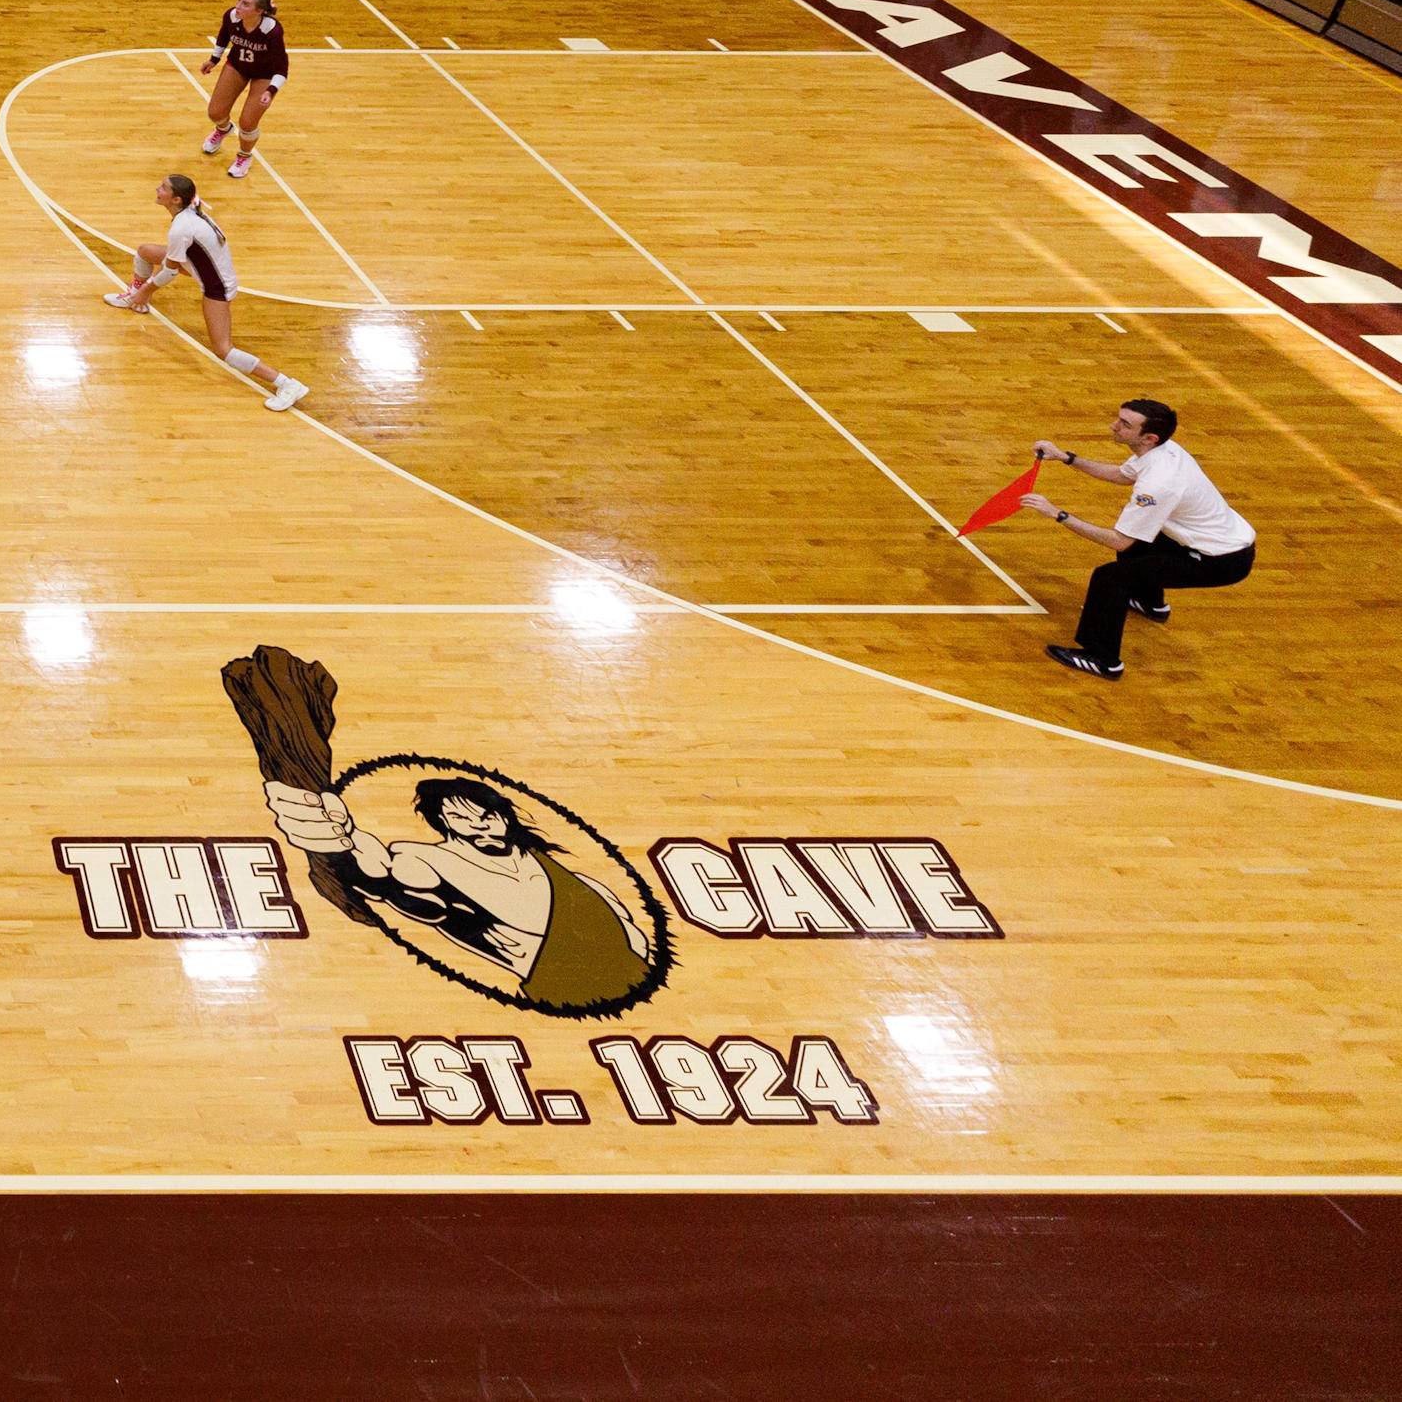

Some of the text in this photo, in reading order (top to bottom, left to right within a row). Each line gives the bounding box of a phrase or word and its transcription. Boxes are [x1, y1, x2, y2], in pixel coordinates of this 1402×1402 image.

[238, 48, 255, 64] 13
[52, 836, 1005, 939] THE CAVE
[342, 1034, 880, 1126] EST. 1924
